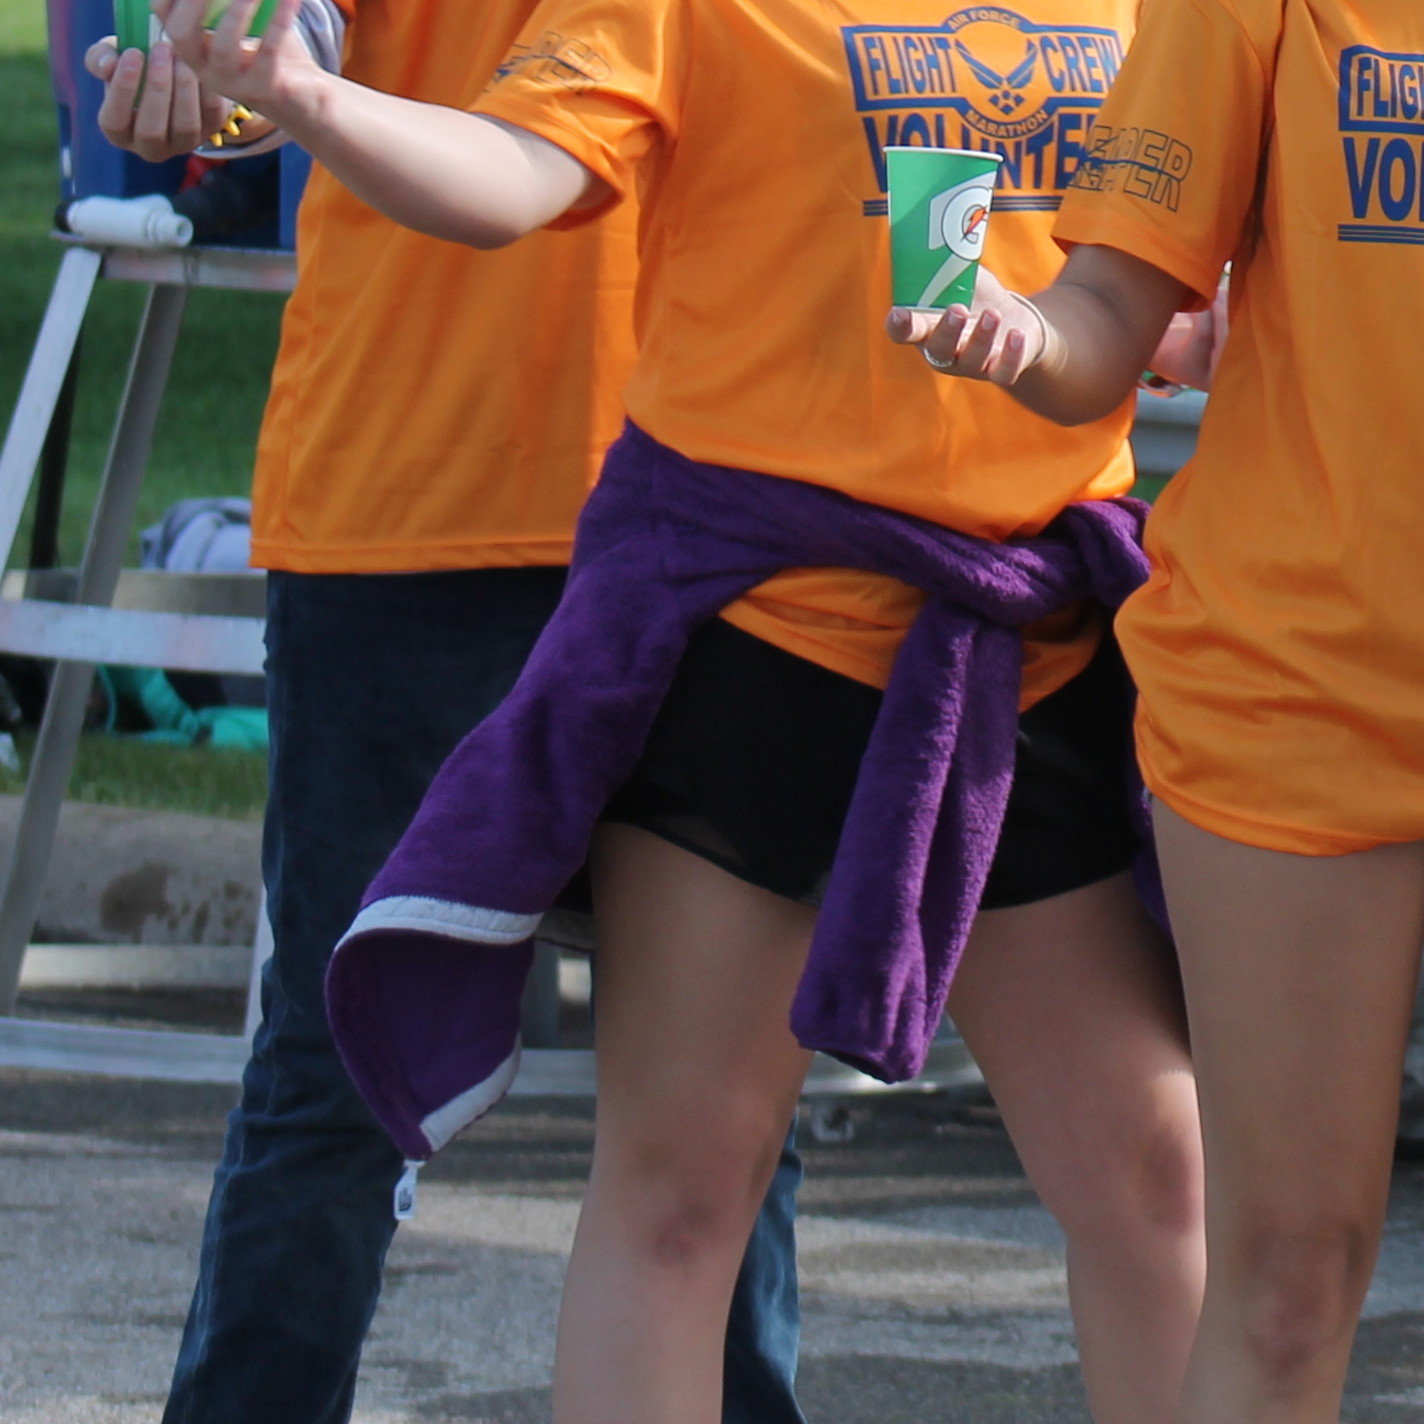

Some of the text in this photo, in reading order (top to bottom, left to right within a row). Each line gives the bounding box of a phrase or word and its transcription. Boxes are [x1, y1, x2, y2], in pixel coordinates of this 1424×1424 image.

[946, 8, 1022, 30] AIR FORCE
[862, 35, 1122, 96] FLIGHT CREW
[964, 109, 1049, 138] MARATHON
